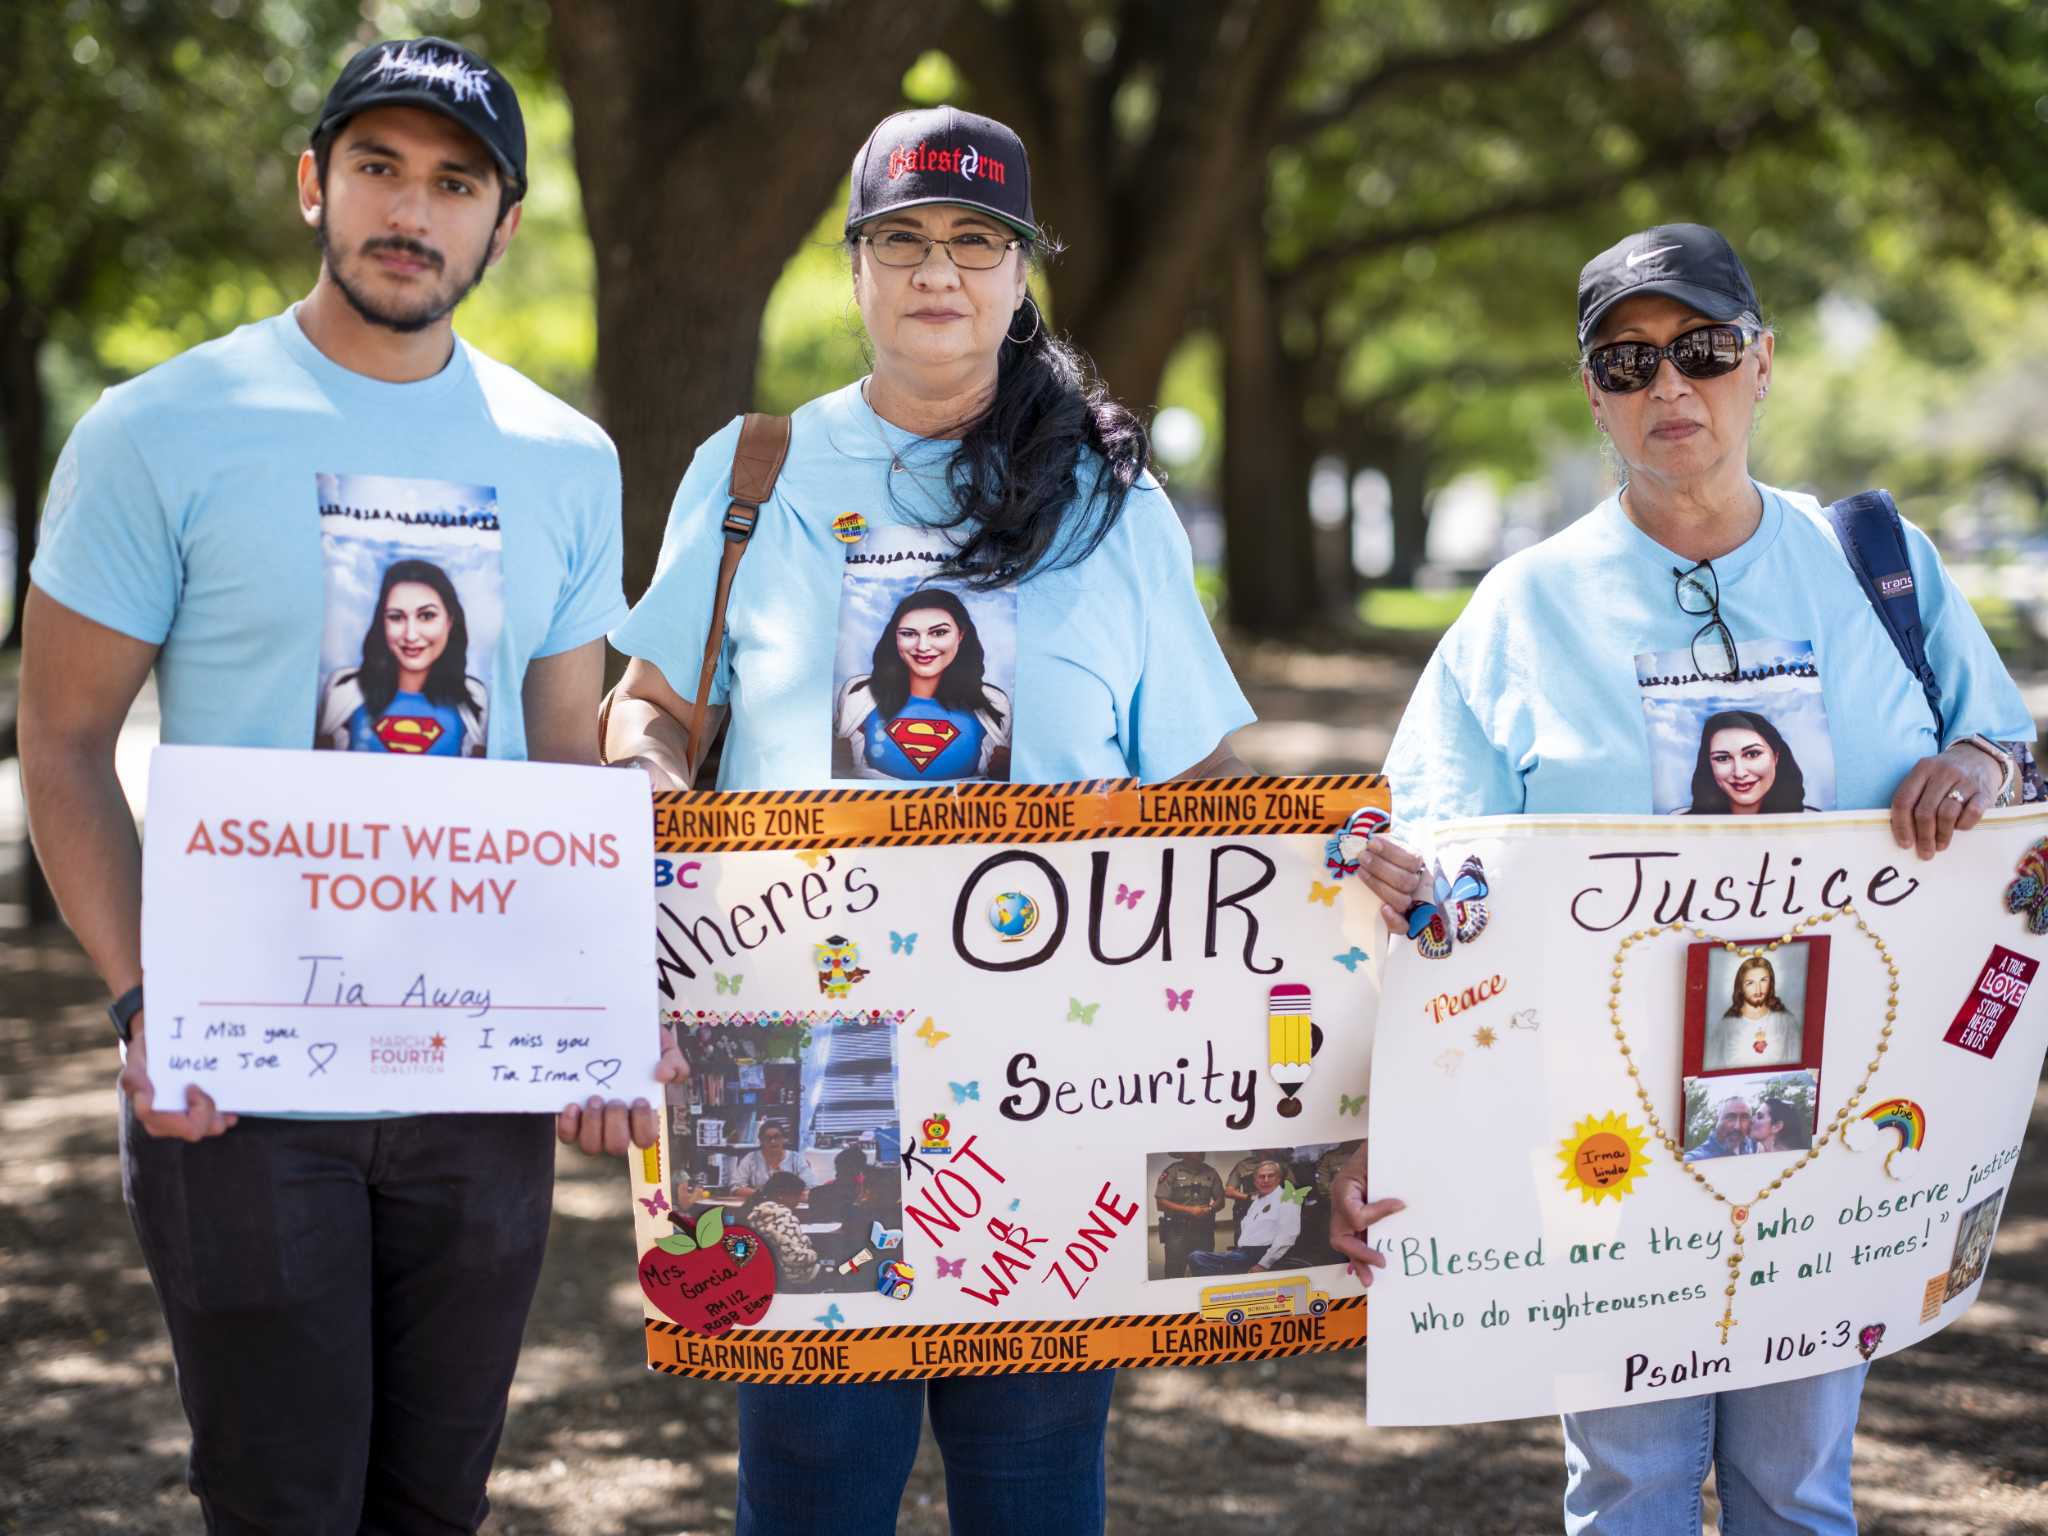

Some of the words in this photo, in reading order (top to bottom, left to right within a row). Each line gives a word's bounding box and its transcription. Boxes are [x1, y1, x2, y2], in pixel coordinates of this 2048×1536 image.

[654, 808, 756, 838] EARNING
[765, 808, 825, 836] ZONE
[890, 801, 1008, 832] LEARNING
[1015, 800, 1075, 829] ZONE
[1140, 795, 1256, 823] LEARNING
[1265, 794, 1325, 820] ZONE
[185, 819, 390, 861] ASSAULT
[402, 826, 620, 869] WEAPONS
[654, 859, 702, 889] BC
[301, 873, 437, 912] TOOK
[451, 879, 518, 914] MY
[1571, 851, 1920, 931] Justice
[952, 844, 1284, 974] OUR
[1998, 955, 2009, 971] A
[2006, 957, 2027, 977] TRUE
[299, 956, 368, 1007] Tia
[401, 974, 492, 1018] Away
[1424, 974, 1508, 1025] Peace
[1979, 967, 2029, 1008] LOVE
[1967, 1013, 1997, 1036] NEVER
[1976, 998, 2006, 1020] STORY
[556, 1035, 590, 1053] you
[1958, 1028, 1988, 1051] ENDS
[237, 1051, 280, 1069] Joe
[370, 1049, 444, 1064] FOURTH
[528, 1065, 581, 1083] Irma
[1582, 1150, 1626, 1165] Irma
[904, 1135, 1006, 1248] NOT
[987, 1216, 1014, 1244] a
[1569, 1240, 1626, 1265] are
[1648, 1226, 1723, 1260] they
[1757, 1207, 1815, 1242] who
[1838, 1183, 1950, 1225] observe
[1042, 1181, 1140, 1300] ZONE
[642, 1263, 686, 1288] Mrs.
[961, 1226, 1050, 1307] WAR
[680, 1267, 738, 1300] Garcia
[1481, 1299, 1510, 1329] do
[1528, 1283, 1706, 1331] righteousness
[1750, 1261, 1780, 1286] at
[1798, 1251, 1832, 1278] all
[705, 1299, 728, 1317] RM
[727, 1289, 750, 1310] 112
[911, 1336, 1023, 1366] LEARNING
[1031, 1335, 1089, 1360] ZONE
[1152, 1323, 1263, 1354] LEARNING
[1269, 1316, 1326, 1345] ZONE
[675, 1340, 784, 1371] LEARNING
[792, 1346, 849, 1371] ZONE
[1624, 1350, 1732, 1393] Psalm
[1765, 1320, 1851, 1364] 106:3
